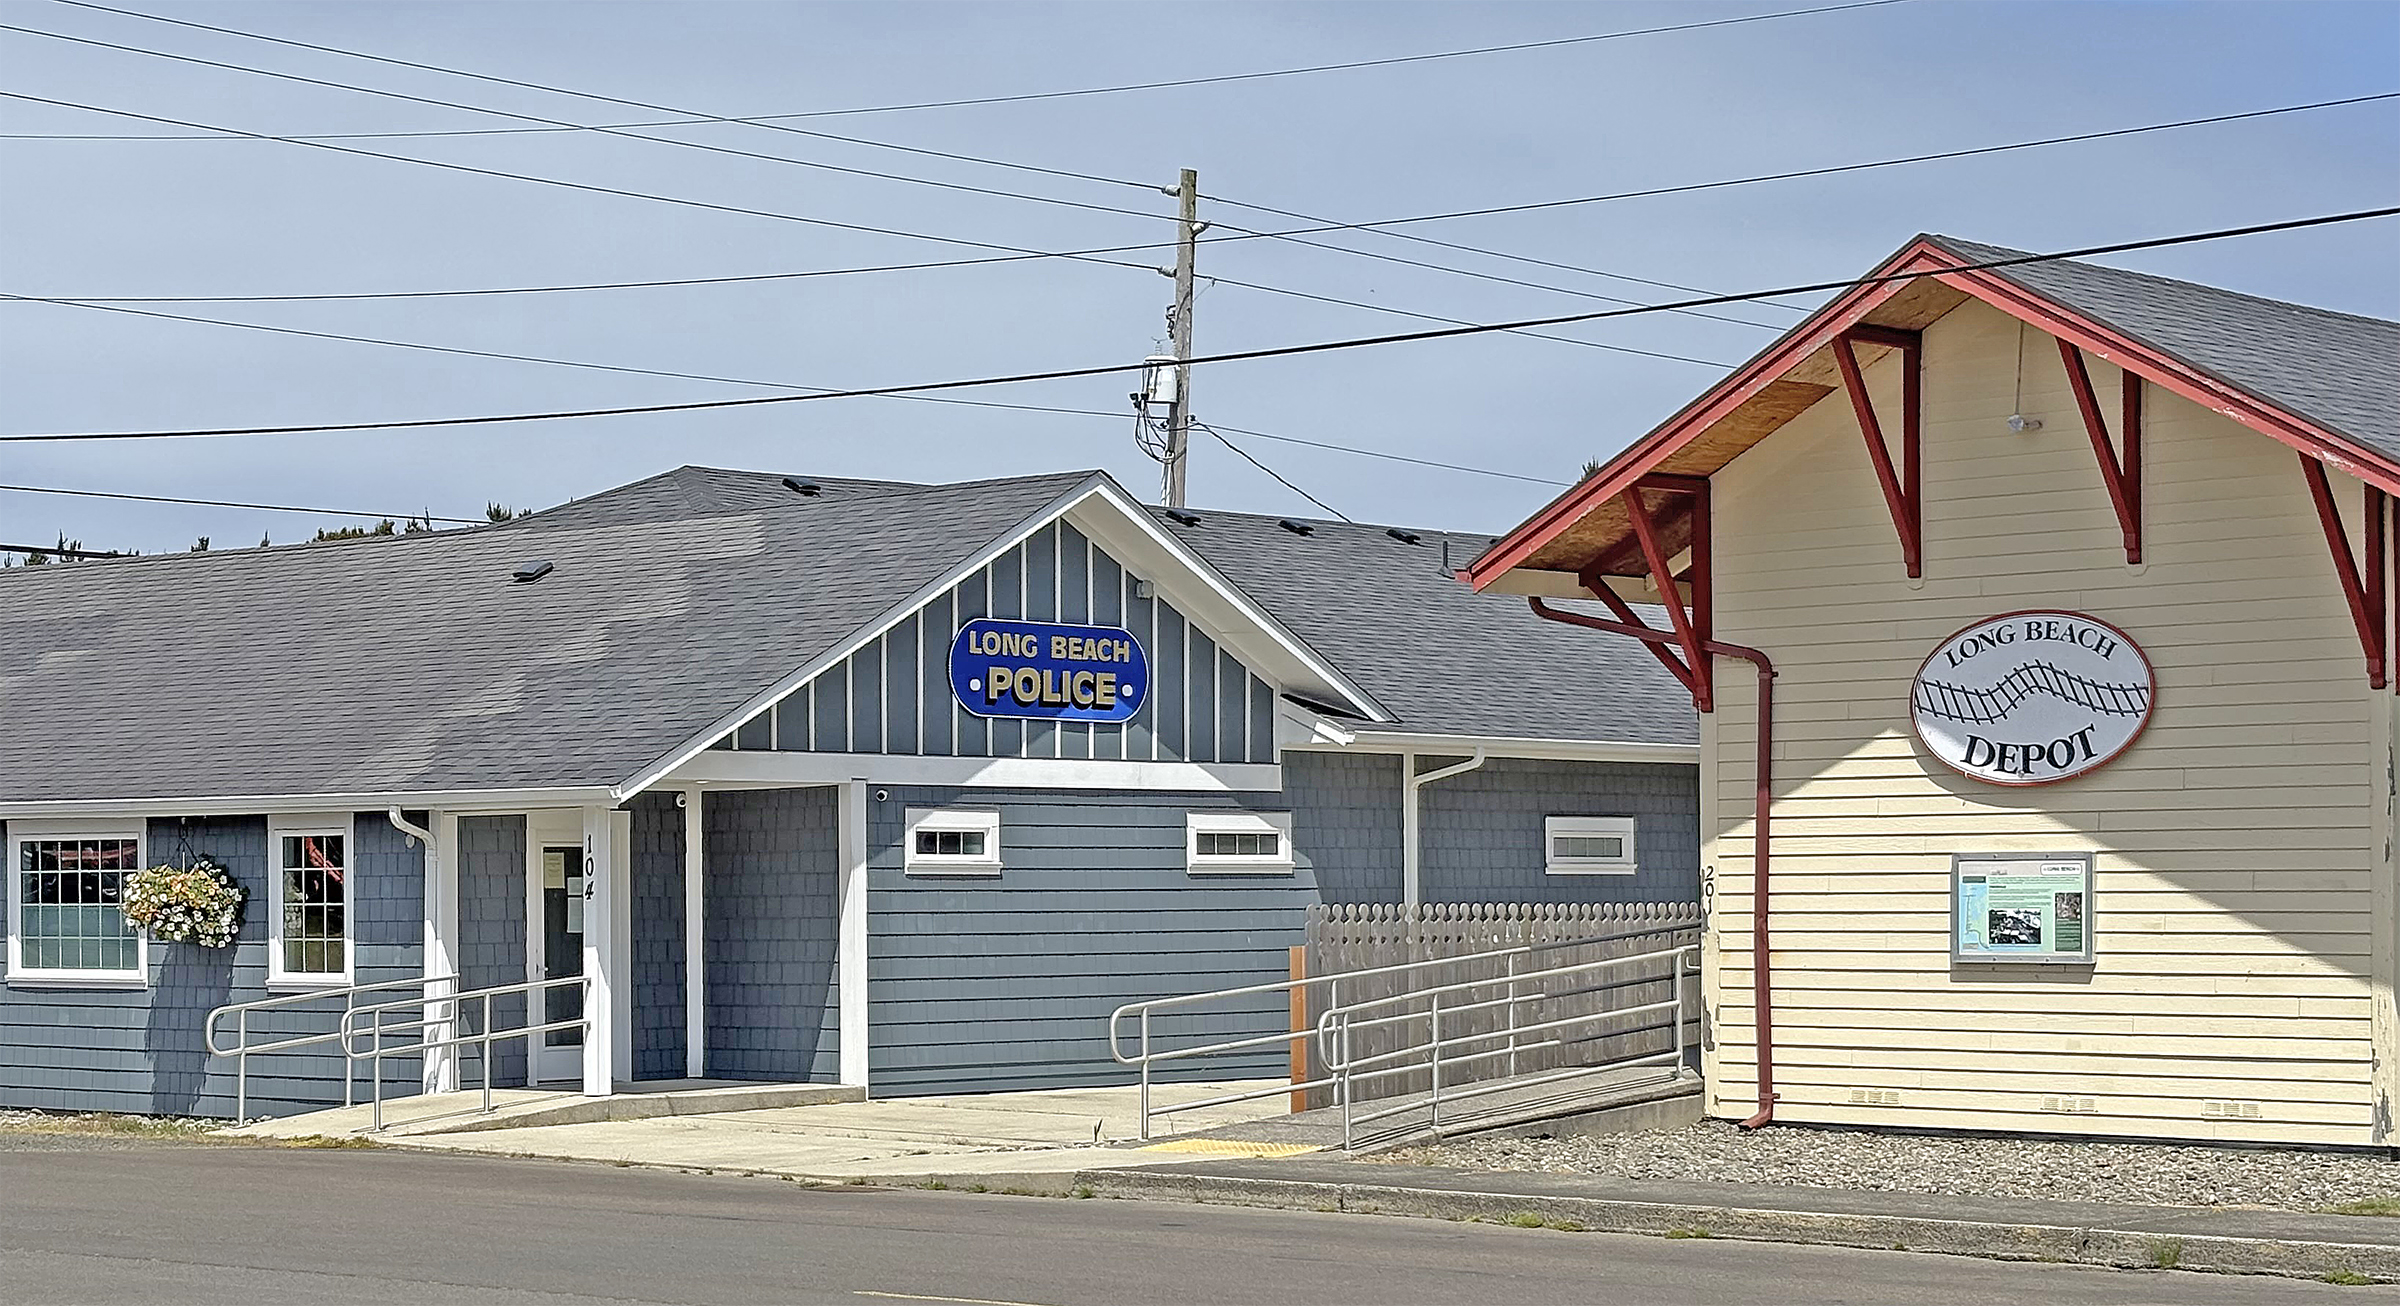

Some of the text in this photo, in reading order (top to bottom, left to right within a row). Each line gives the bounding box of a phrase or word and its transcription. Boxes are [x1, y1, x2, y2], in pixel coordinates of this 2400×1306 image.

[968, 630, 1130, 663] LONG BEACH
[1943, 620, 2118, 669] LONG BEACH
[987, 666, 1117, 707] POLICE
[1960, 723, 2098, 775] DEPOT
[584, 833, 595, 900] 104
[1705, 865, 1714, 915] 201
